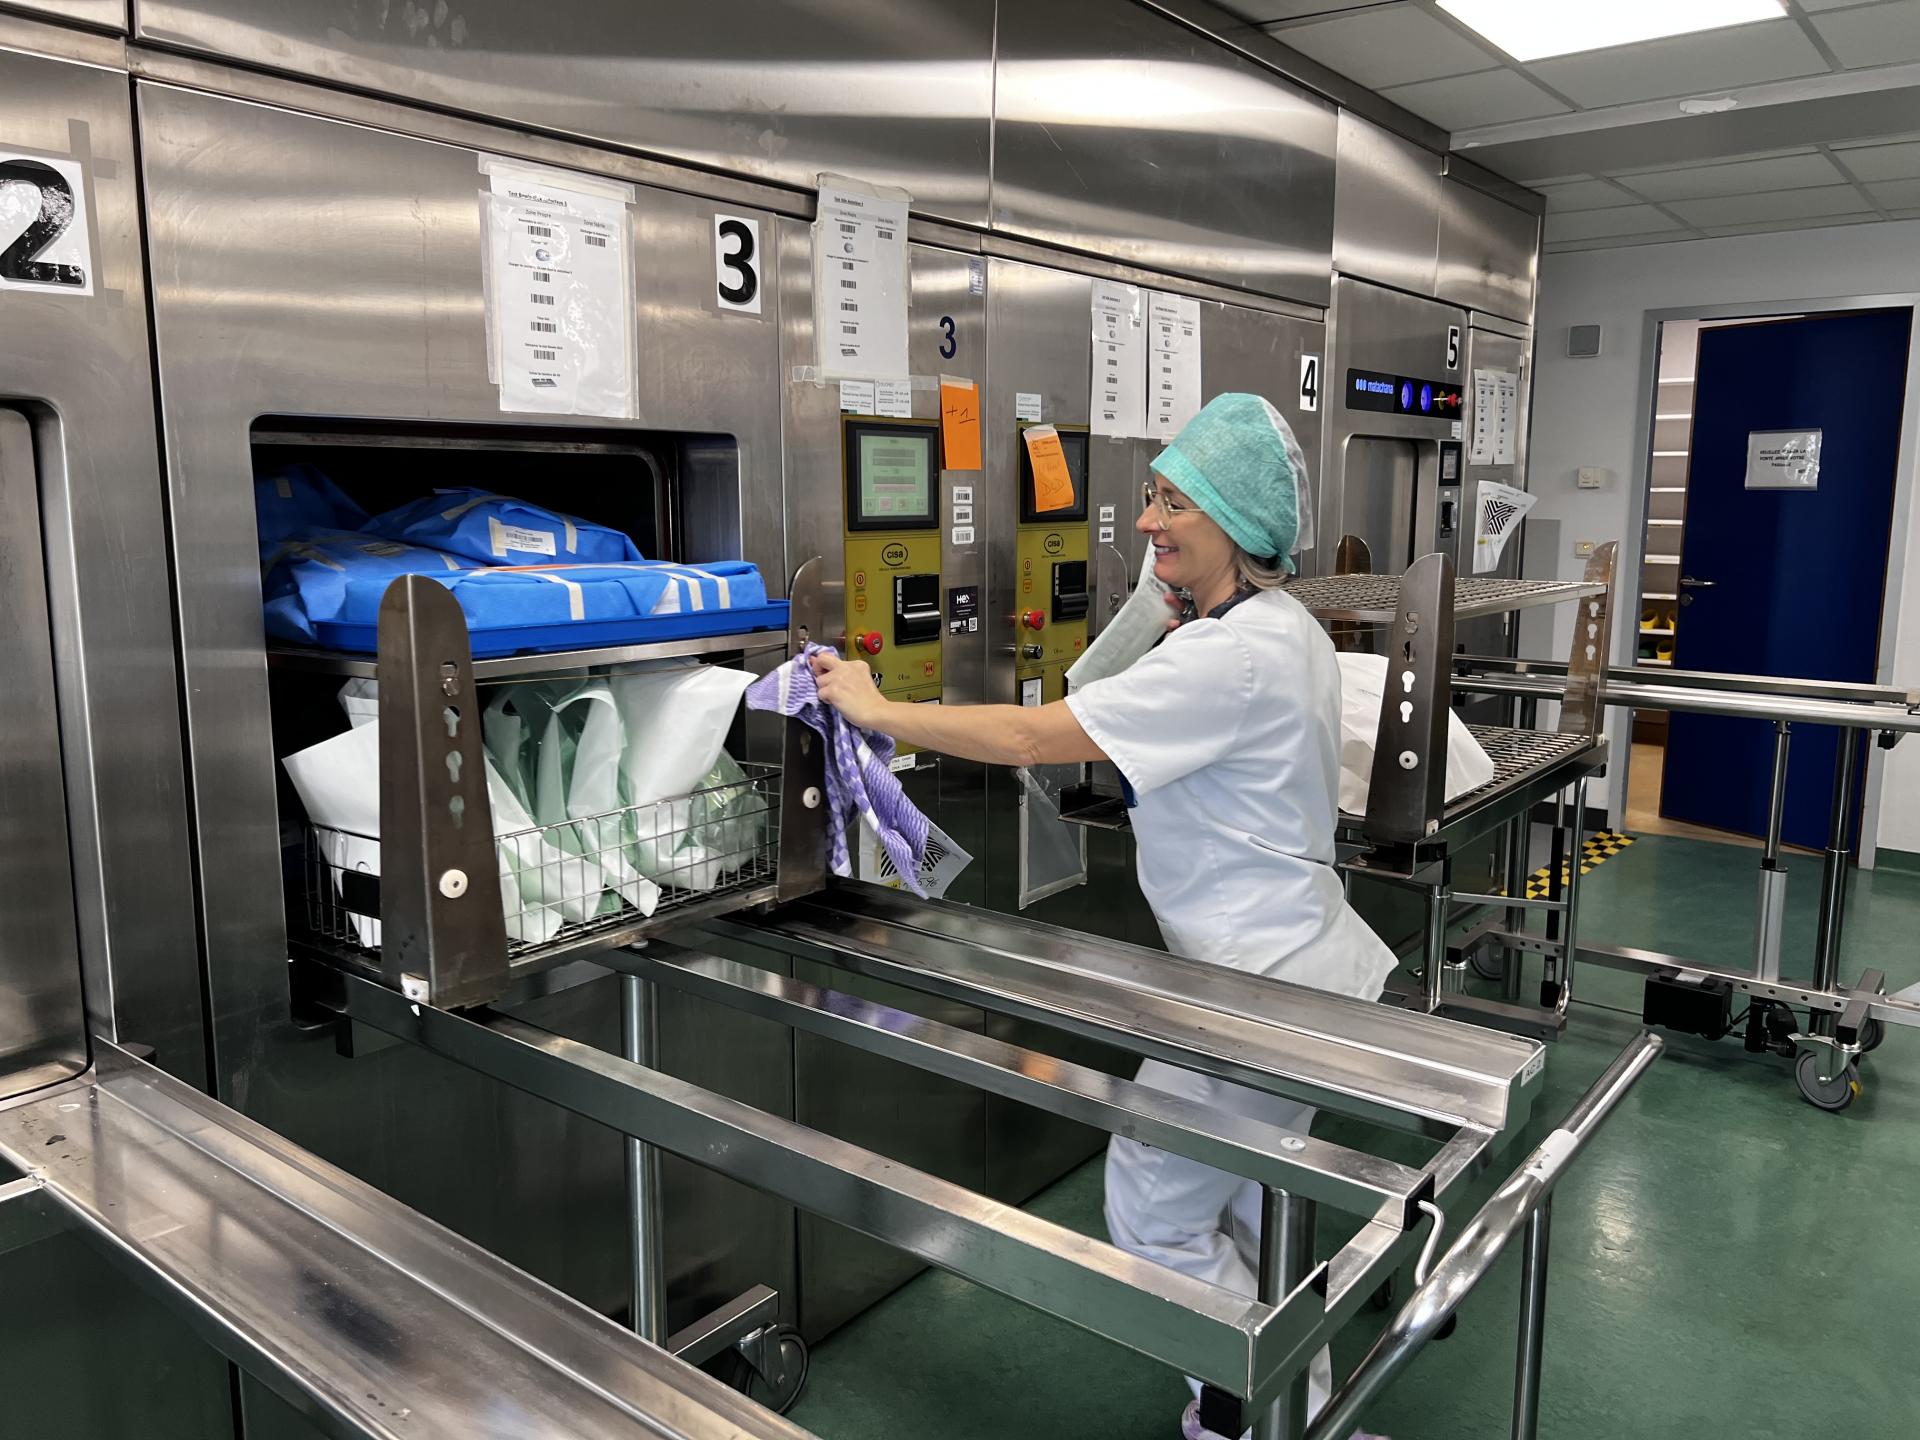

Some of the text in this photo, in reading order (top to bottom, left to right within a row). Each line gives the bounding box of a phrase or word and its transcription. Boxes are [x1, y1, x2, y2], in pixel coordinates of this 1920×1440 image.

[0, 159, 85, 287] 2
[719, 220, 757, 305] 3
[939, 316, 957, 359] 3
[1448, 329, 1458, 368] 5
[1302, 360, 1316, 407] 4
[1367, 381, 1394, 395] matachana
